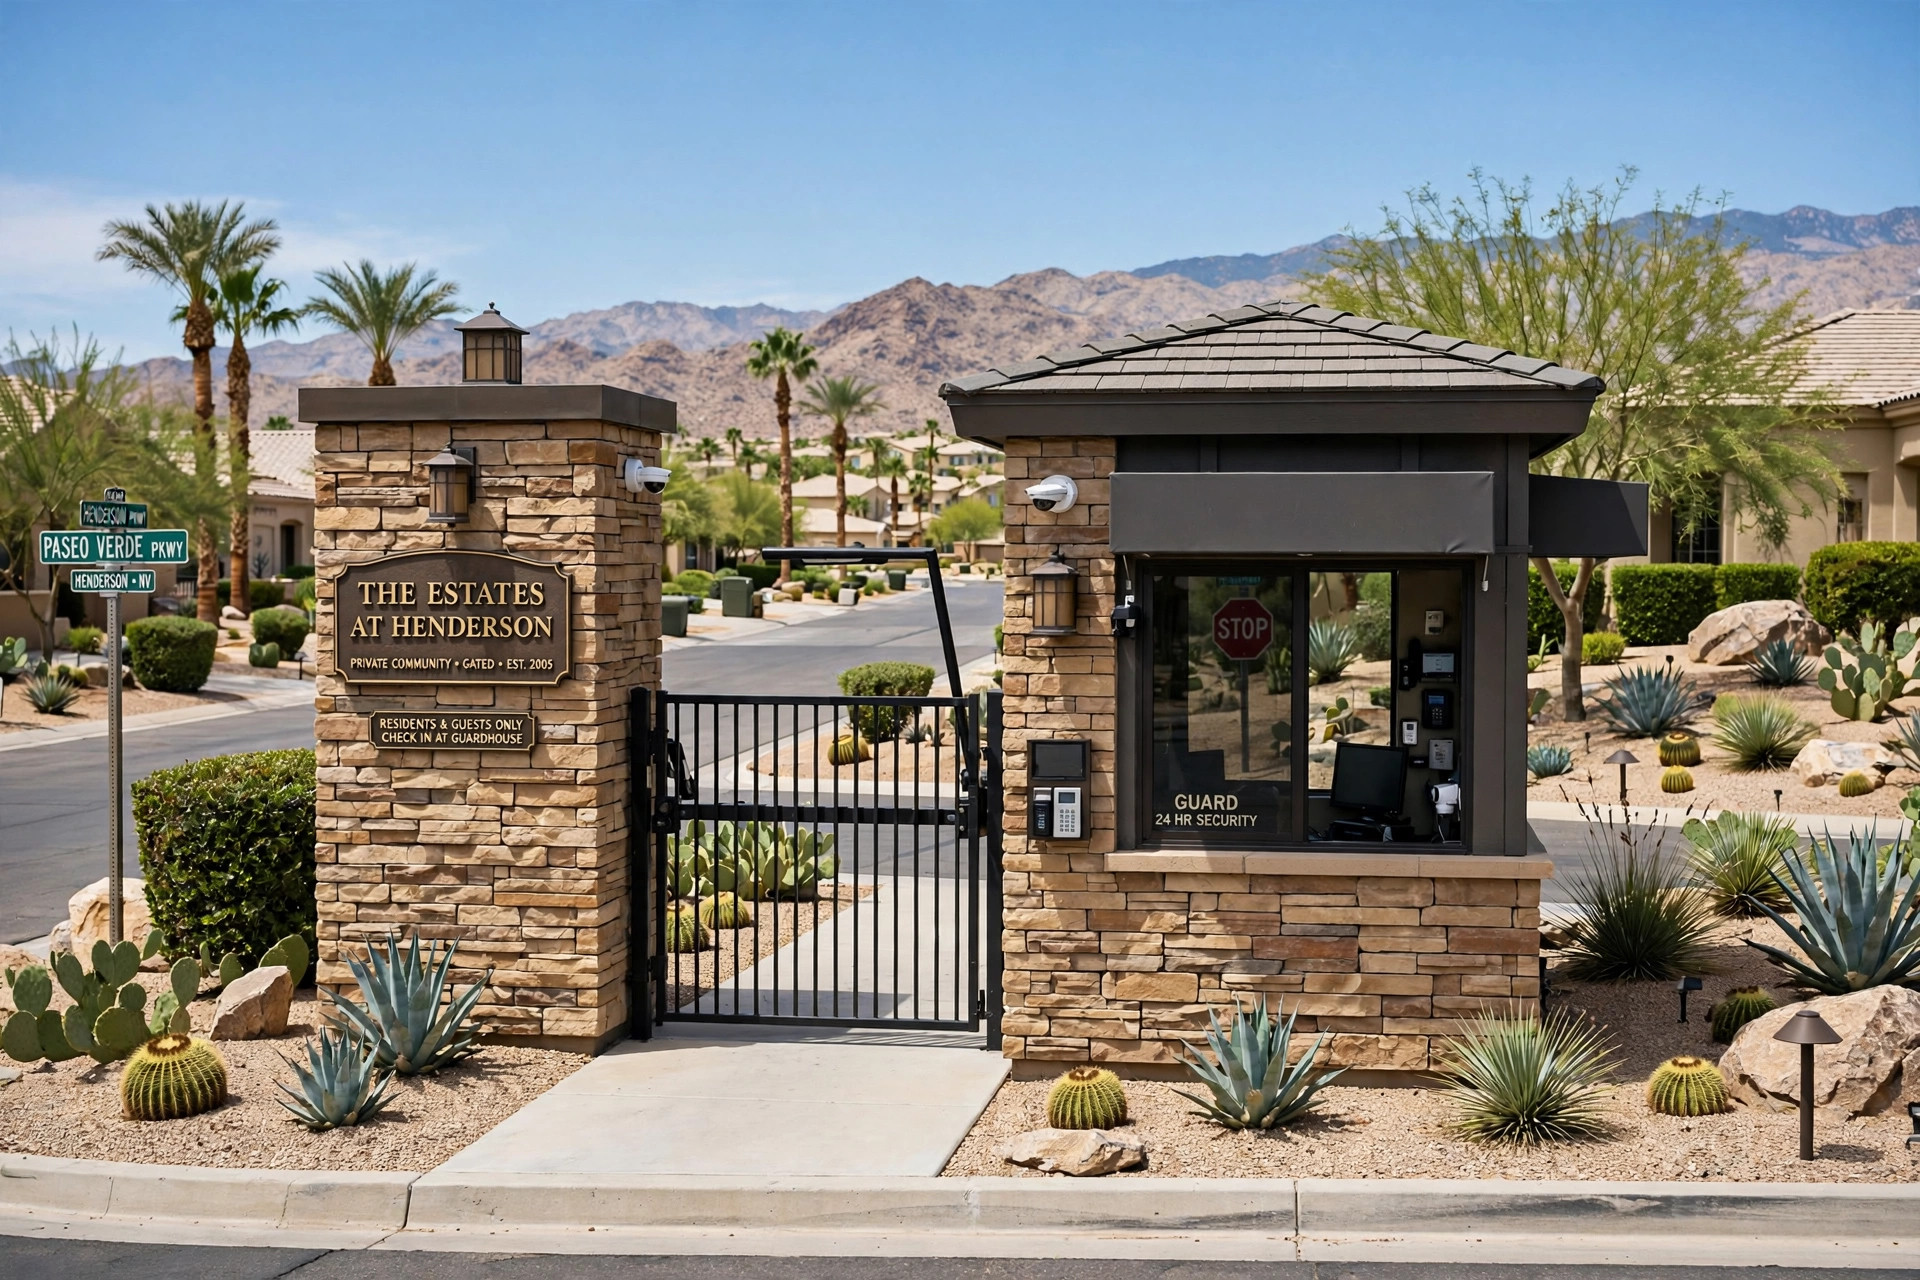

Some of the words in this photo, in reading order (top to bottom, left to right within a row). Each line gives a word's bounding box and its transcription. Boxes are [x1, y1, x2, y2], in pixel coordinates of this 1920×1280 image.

[43, 536, 89, 559] PASEO
[96, 535, 144, 559] VERDE
[151, 541, 183, 558] PKWY
[75, 573, 129, 589] HENDERSON
[139, 573, 151, 589] NV
[357, 581, 416, 605] THE
[427, 581, 544, 605] ESTATES
[350, 615, 383, 638] AT
[391, 615, 553, 638] HENDERSON
[1217, 617, 1269, 640] STOP
[350, 657, 388, 669] PRIVATE
[391, 658, 452, 670] COMMUNITY
[462, 658, 495, 670] GATED
[506, 658, 527, 670] EST.
[529, 658, 553, 670] 2005
[379, 718, 437, 730] RESIDENTS
[439, 718, 448, 730] &
[451, 718, 492, 730] GUESTS
[495, 719, 524, 731] ONLY
[381, 732, 418, 743] CHECK
[420, 732, 432, 743] IN
[435, 732, 448, 743] AT
[451, 732, 523, 744] GUARDHOUSE
[1174, 793, 1239, 811] GUARD
[1155, 813, 1172, 826] 24
[1174, 813, 1193, 826] HR
[1196, 813, 1258, 828] SECURITY
